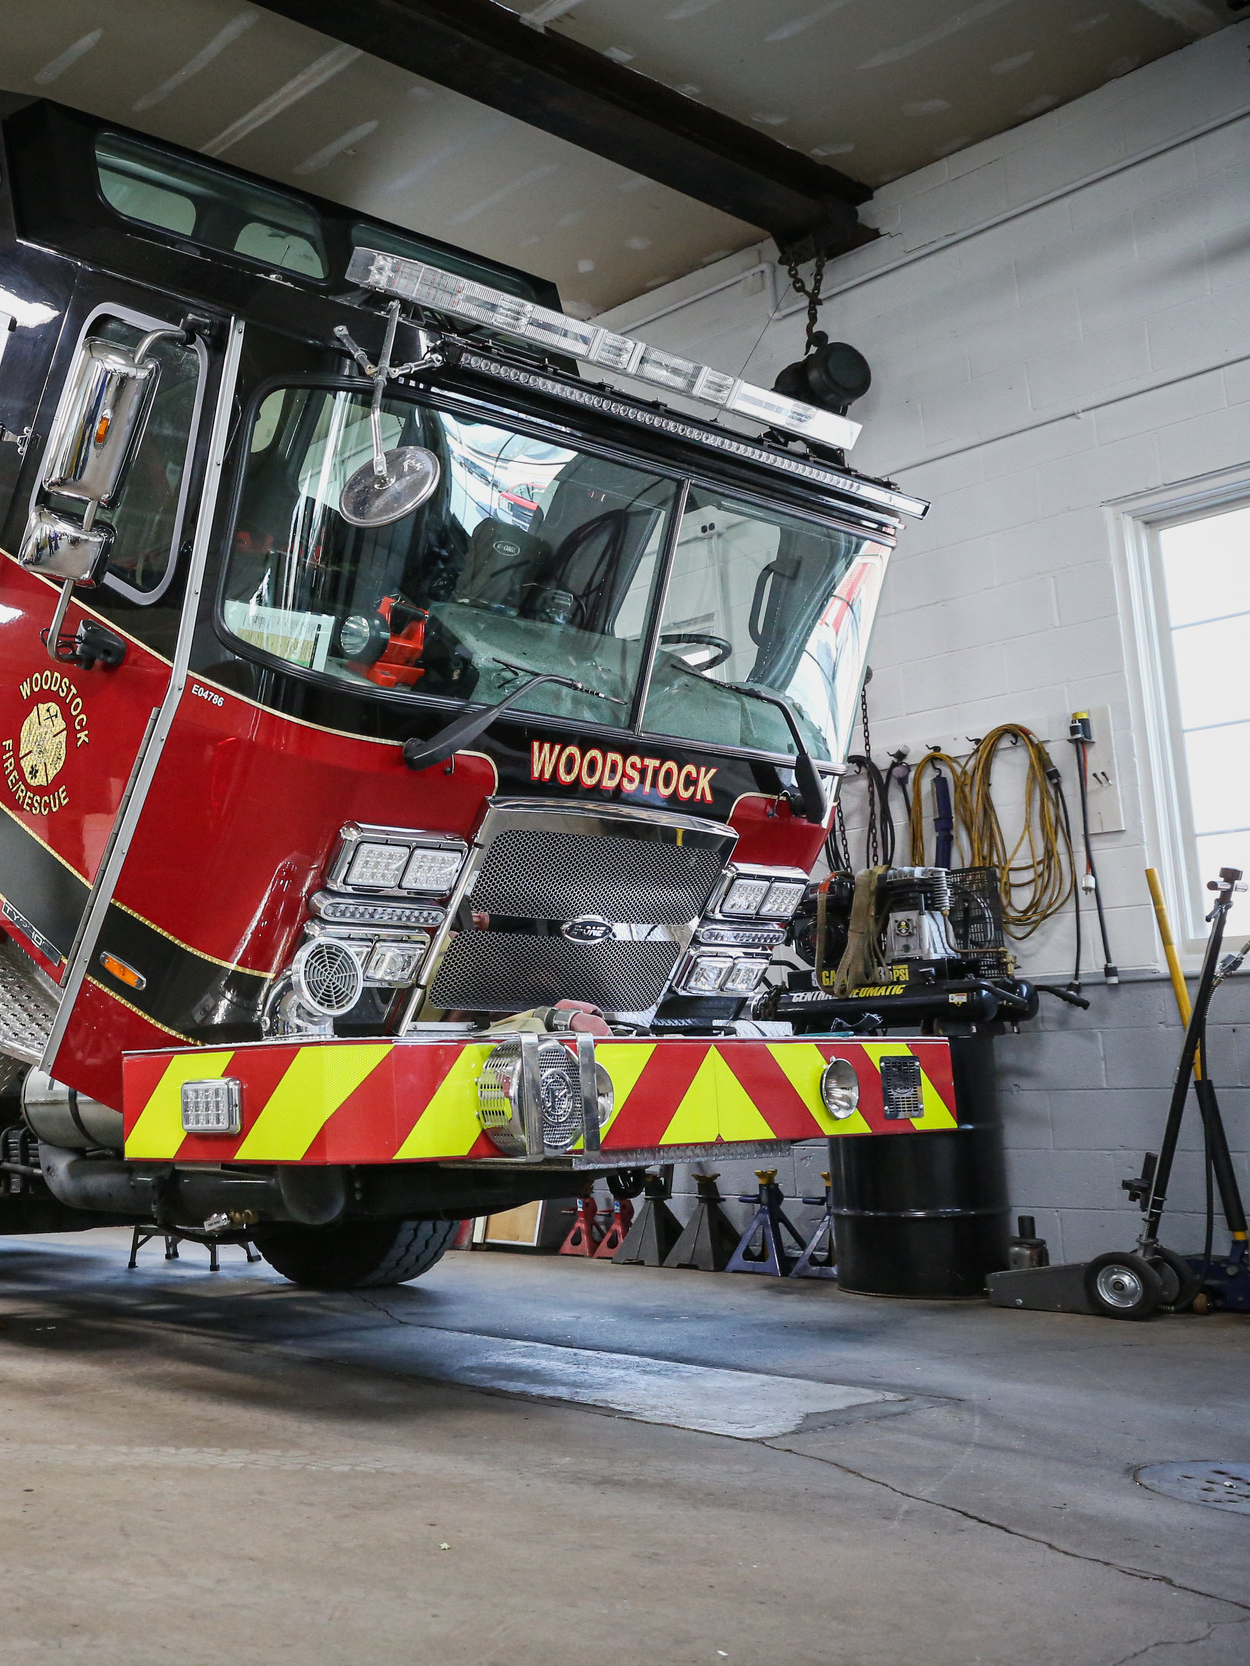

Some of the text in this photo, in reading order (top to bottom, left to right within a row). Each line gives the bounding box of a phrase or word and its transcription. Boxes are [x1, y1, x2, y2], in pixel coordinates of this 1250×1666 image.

[19, 669, 90, 749] WOODSTOCK
[191, 683, 225, 707] E04786
[1, 738, 70, 816] FIRE/RESCUE
[530, 740, 719, 804] WOODSTOCK
[791, 985, 907, 1003] CENTRA NEUMATIC
[893, 968, 910, 982] PSI
